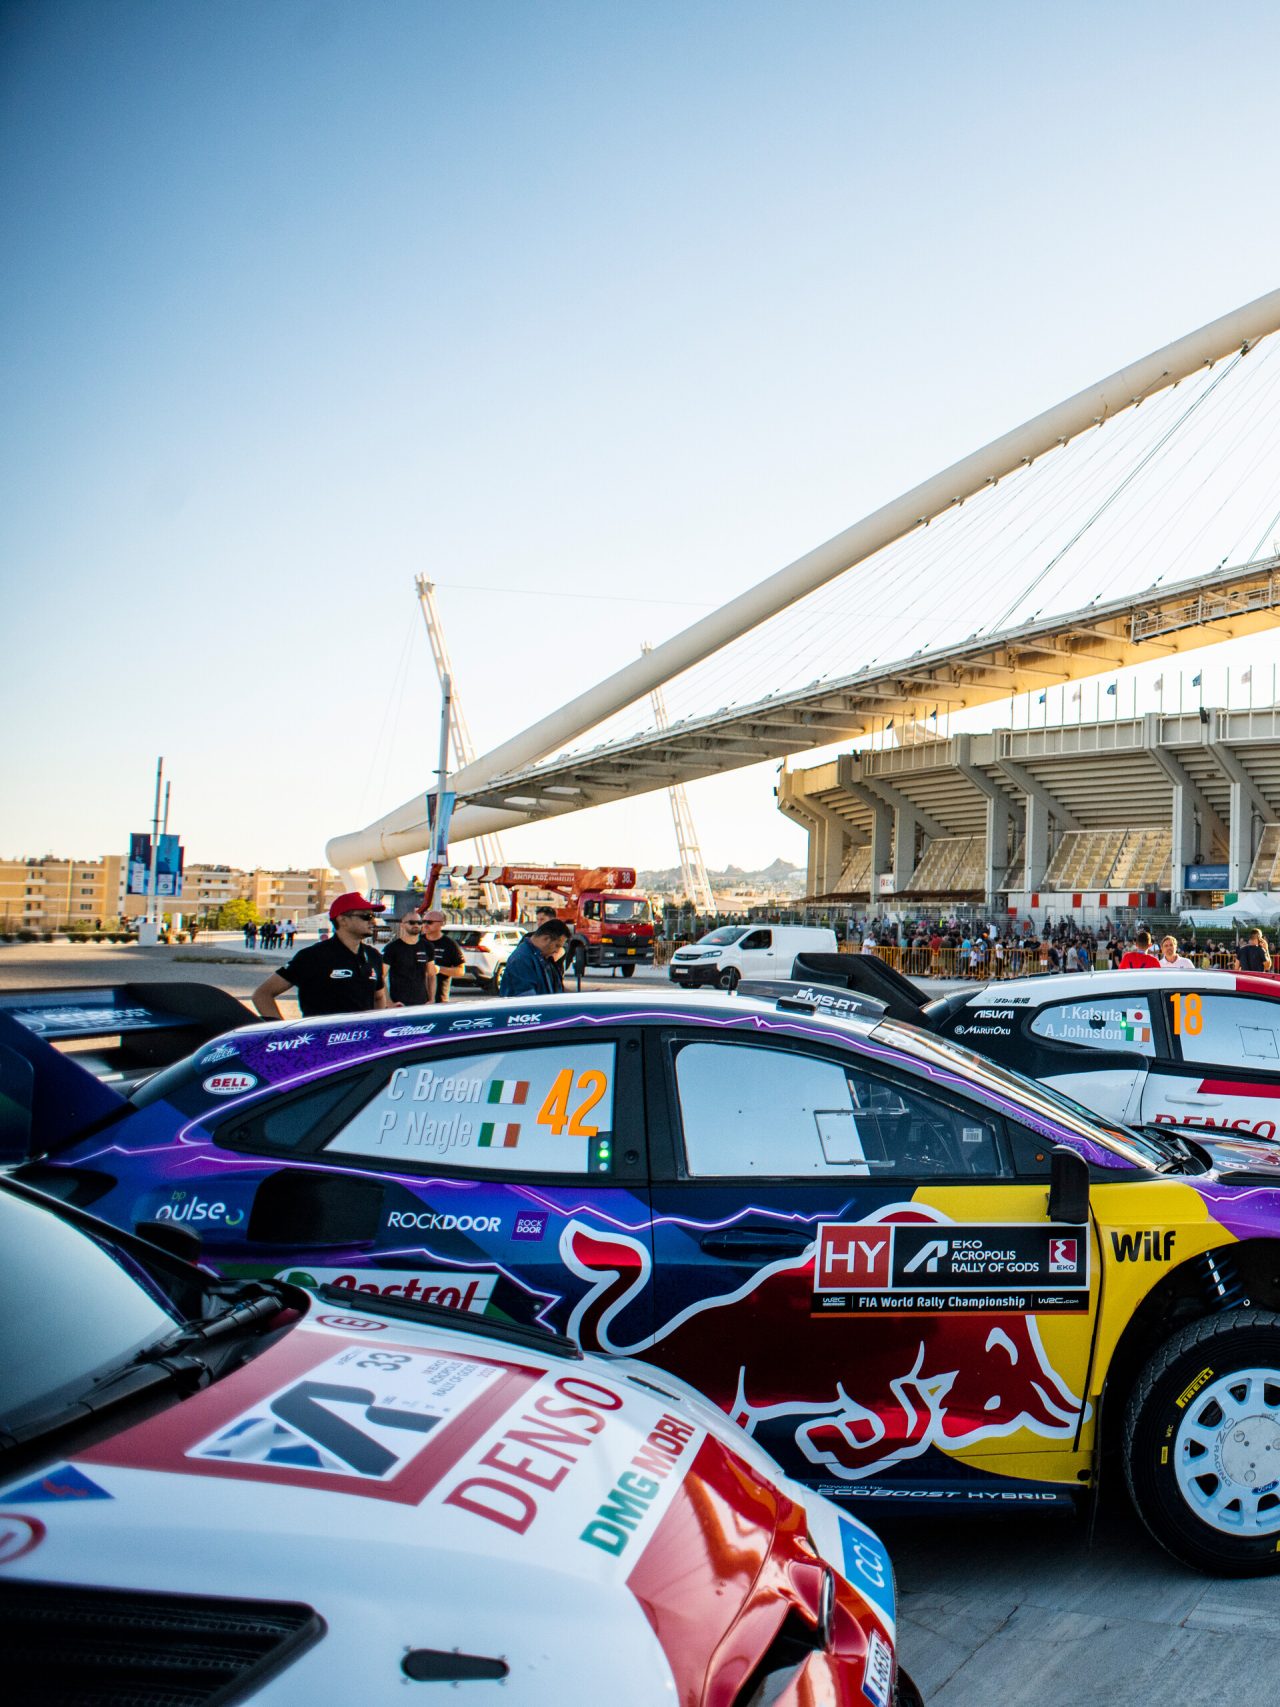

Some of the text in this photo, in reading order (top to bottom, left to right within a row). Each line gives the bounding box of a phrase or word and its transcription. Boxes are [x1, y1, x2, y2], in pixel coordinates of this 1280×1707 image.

[508, 1014, 542, 1024] NGK
[1060, 1005, 1122, 1022] T.Katsuta
[1170, 993, 1203, 1036] 18
[327, 1030, 370, 1046] ENDLESS
[1045, 1024, 1122, 1041] A.Johnston
[210, 1077, 248, 1088] BELL
[388, 1068, 483, 1103] C Breen
[536, 1068, 608, 1137] 42
[376, 1110, 472, 1154] P Nagle
[155, 1196, 226, 1221] pulse
[387, 1211, 502, 1232] ROCKDOOR
[516, 1226, 542, 1234] DOOR
[518, 1219, 543, 1227] ROCK
[952, 1240, 982, 1249] EKO
[1111, 1230, 1176, 1262] Wilf
[824, 1240, 887, 1273] HY
[952, 1250, 1016, 1261] ACROPOLIS
[951, 1262, 1039, 1273] RALLY OF GODS
[858, 1296, 1026, 1309] FIA World Rally Championship
[356, 1352, 413, 1372] 33
[1175, 1366, 1215, 1409] PIRELLI
[442, 1377, 624, 1536] DENSO
[1214, 1445, 1231, 1488] RACING
[579, 1413, 696, 1557] DMG MORI
[816, 1488, 1057, 1500] ECOBOOST HYBRID
